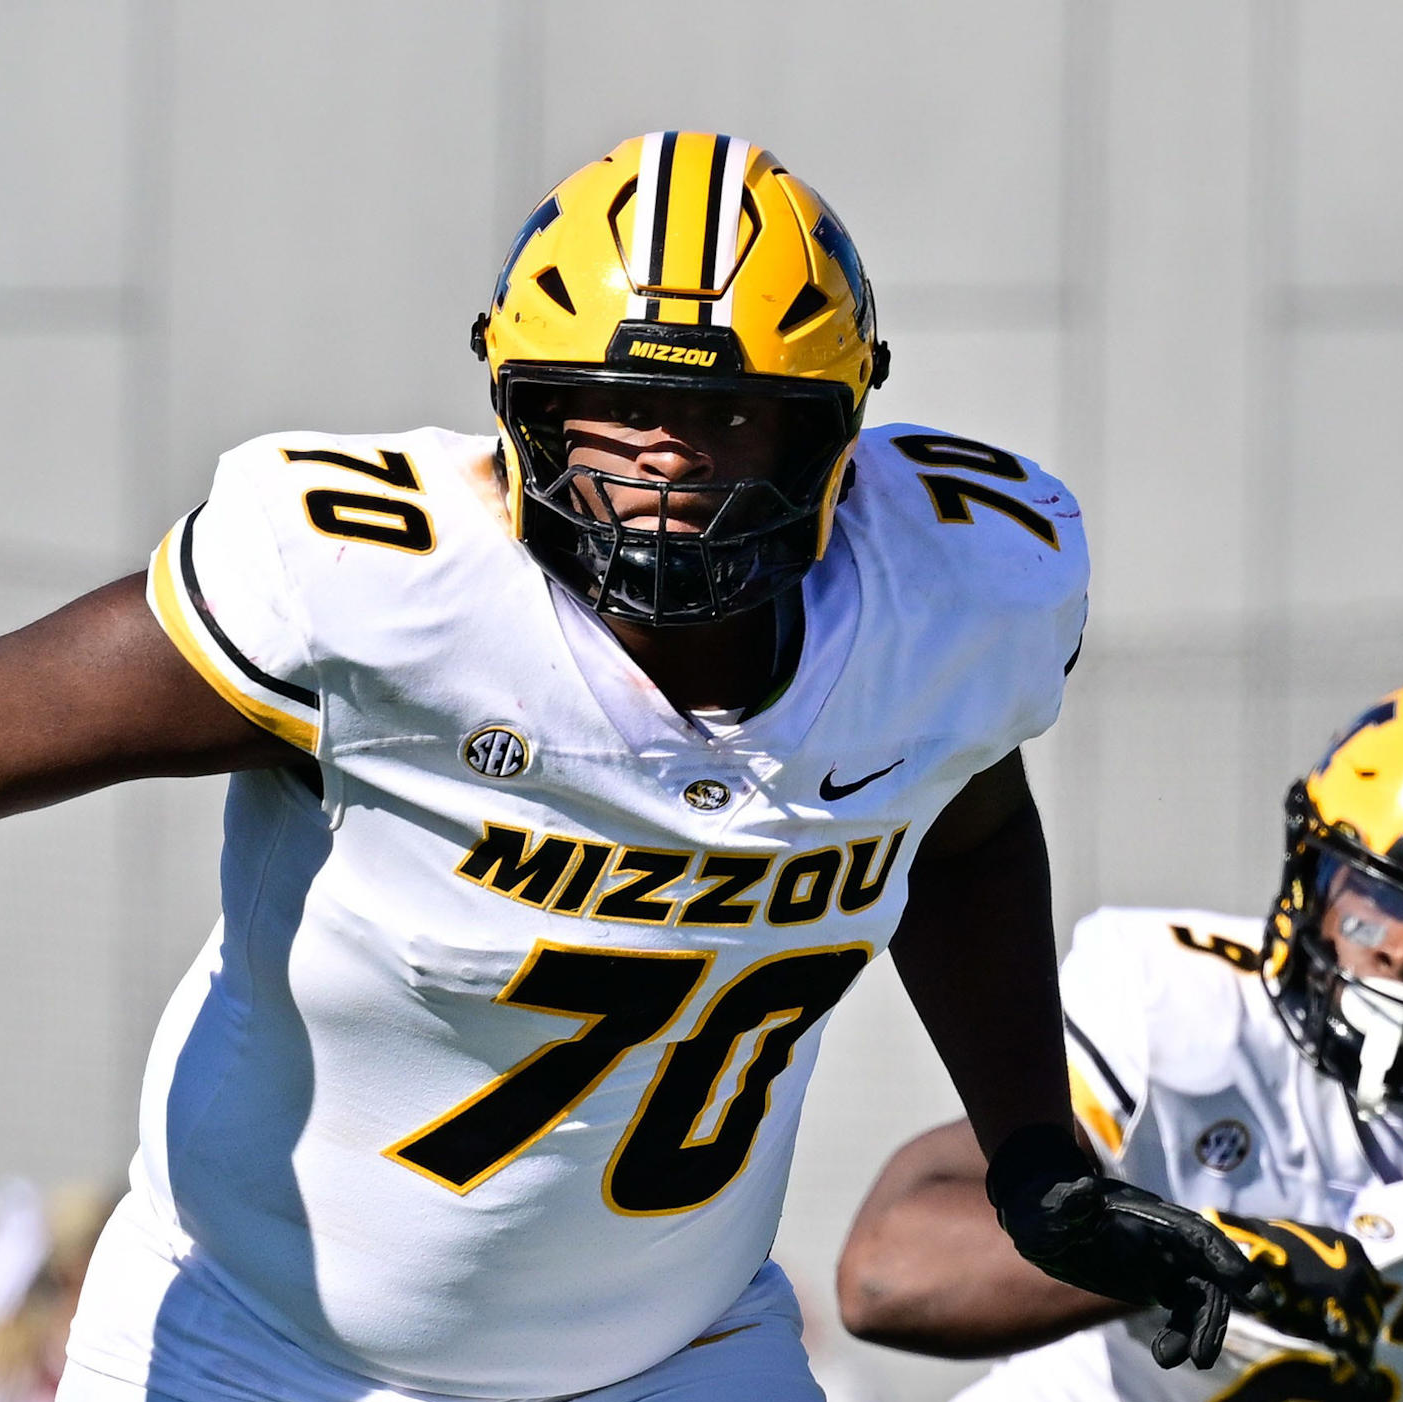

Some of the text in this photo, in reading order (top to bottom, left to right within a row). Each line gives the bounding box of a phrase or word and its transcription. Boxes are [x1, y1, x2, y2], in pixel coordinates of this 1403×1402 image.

[628, 340, 717, 367] MIZZOU
[279, 446, 438, 556] 70
[890, 433, 1061, 552] 70
[468, 730, 524, 777] SEC
[453, 820, 908, 927] MIZZOU
[381, 937, 875, 1218] 70
